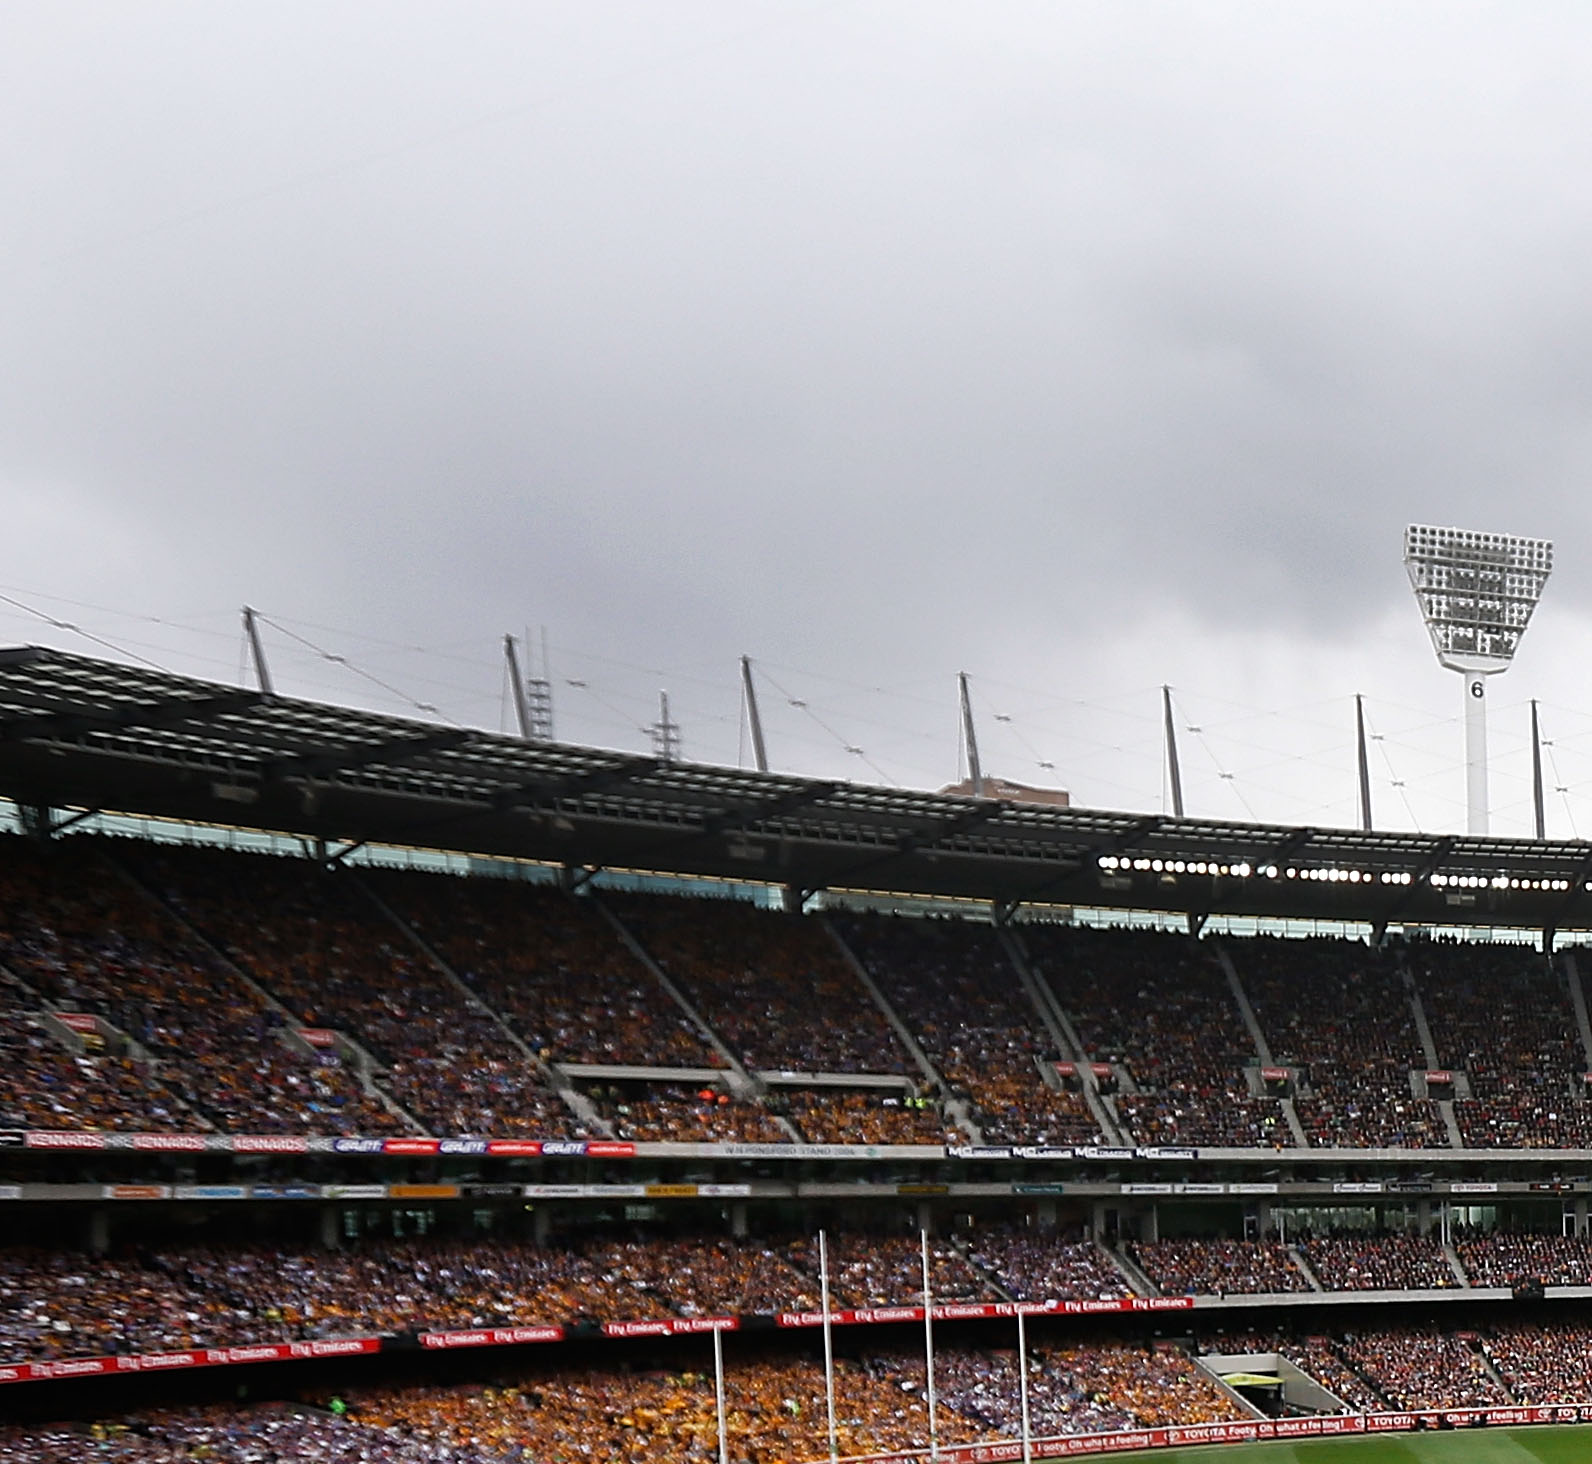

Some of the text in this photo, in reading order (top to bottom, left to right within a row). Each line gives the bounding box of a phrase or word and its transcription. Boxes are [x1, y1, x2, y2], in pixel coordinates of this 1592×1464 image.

[996, 1303, 1013, 1316] Fly
[1065, 1298, 1120, 1312] Fly Emirates
[1133, 1296, 1187, 1310] Fly Emirates
[856, 1308, 915, 1322] Fly Emirates
[945, 1305, 984, 1317] Emirates
[674, 1317, 734, 1331] Fly Emirates
[783, 1313, 801, 1326] Fly
[1183, 1429, 1225, 1440] TOYOTA
[1259, 1424, 1274, 1434] Oh
[1276, 1421, 1300, 1432] what
[1309, 1418, 1345, 1431] feeling!
[1069, 1437, 1083, 1450] Oh
